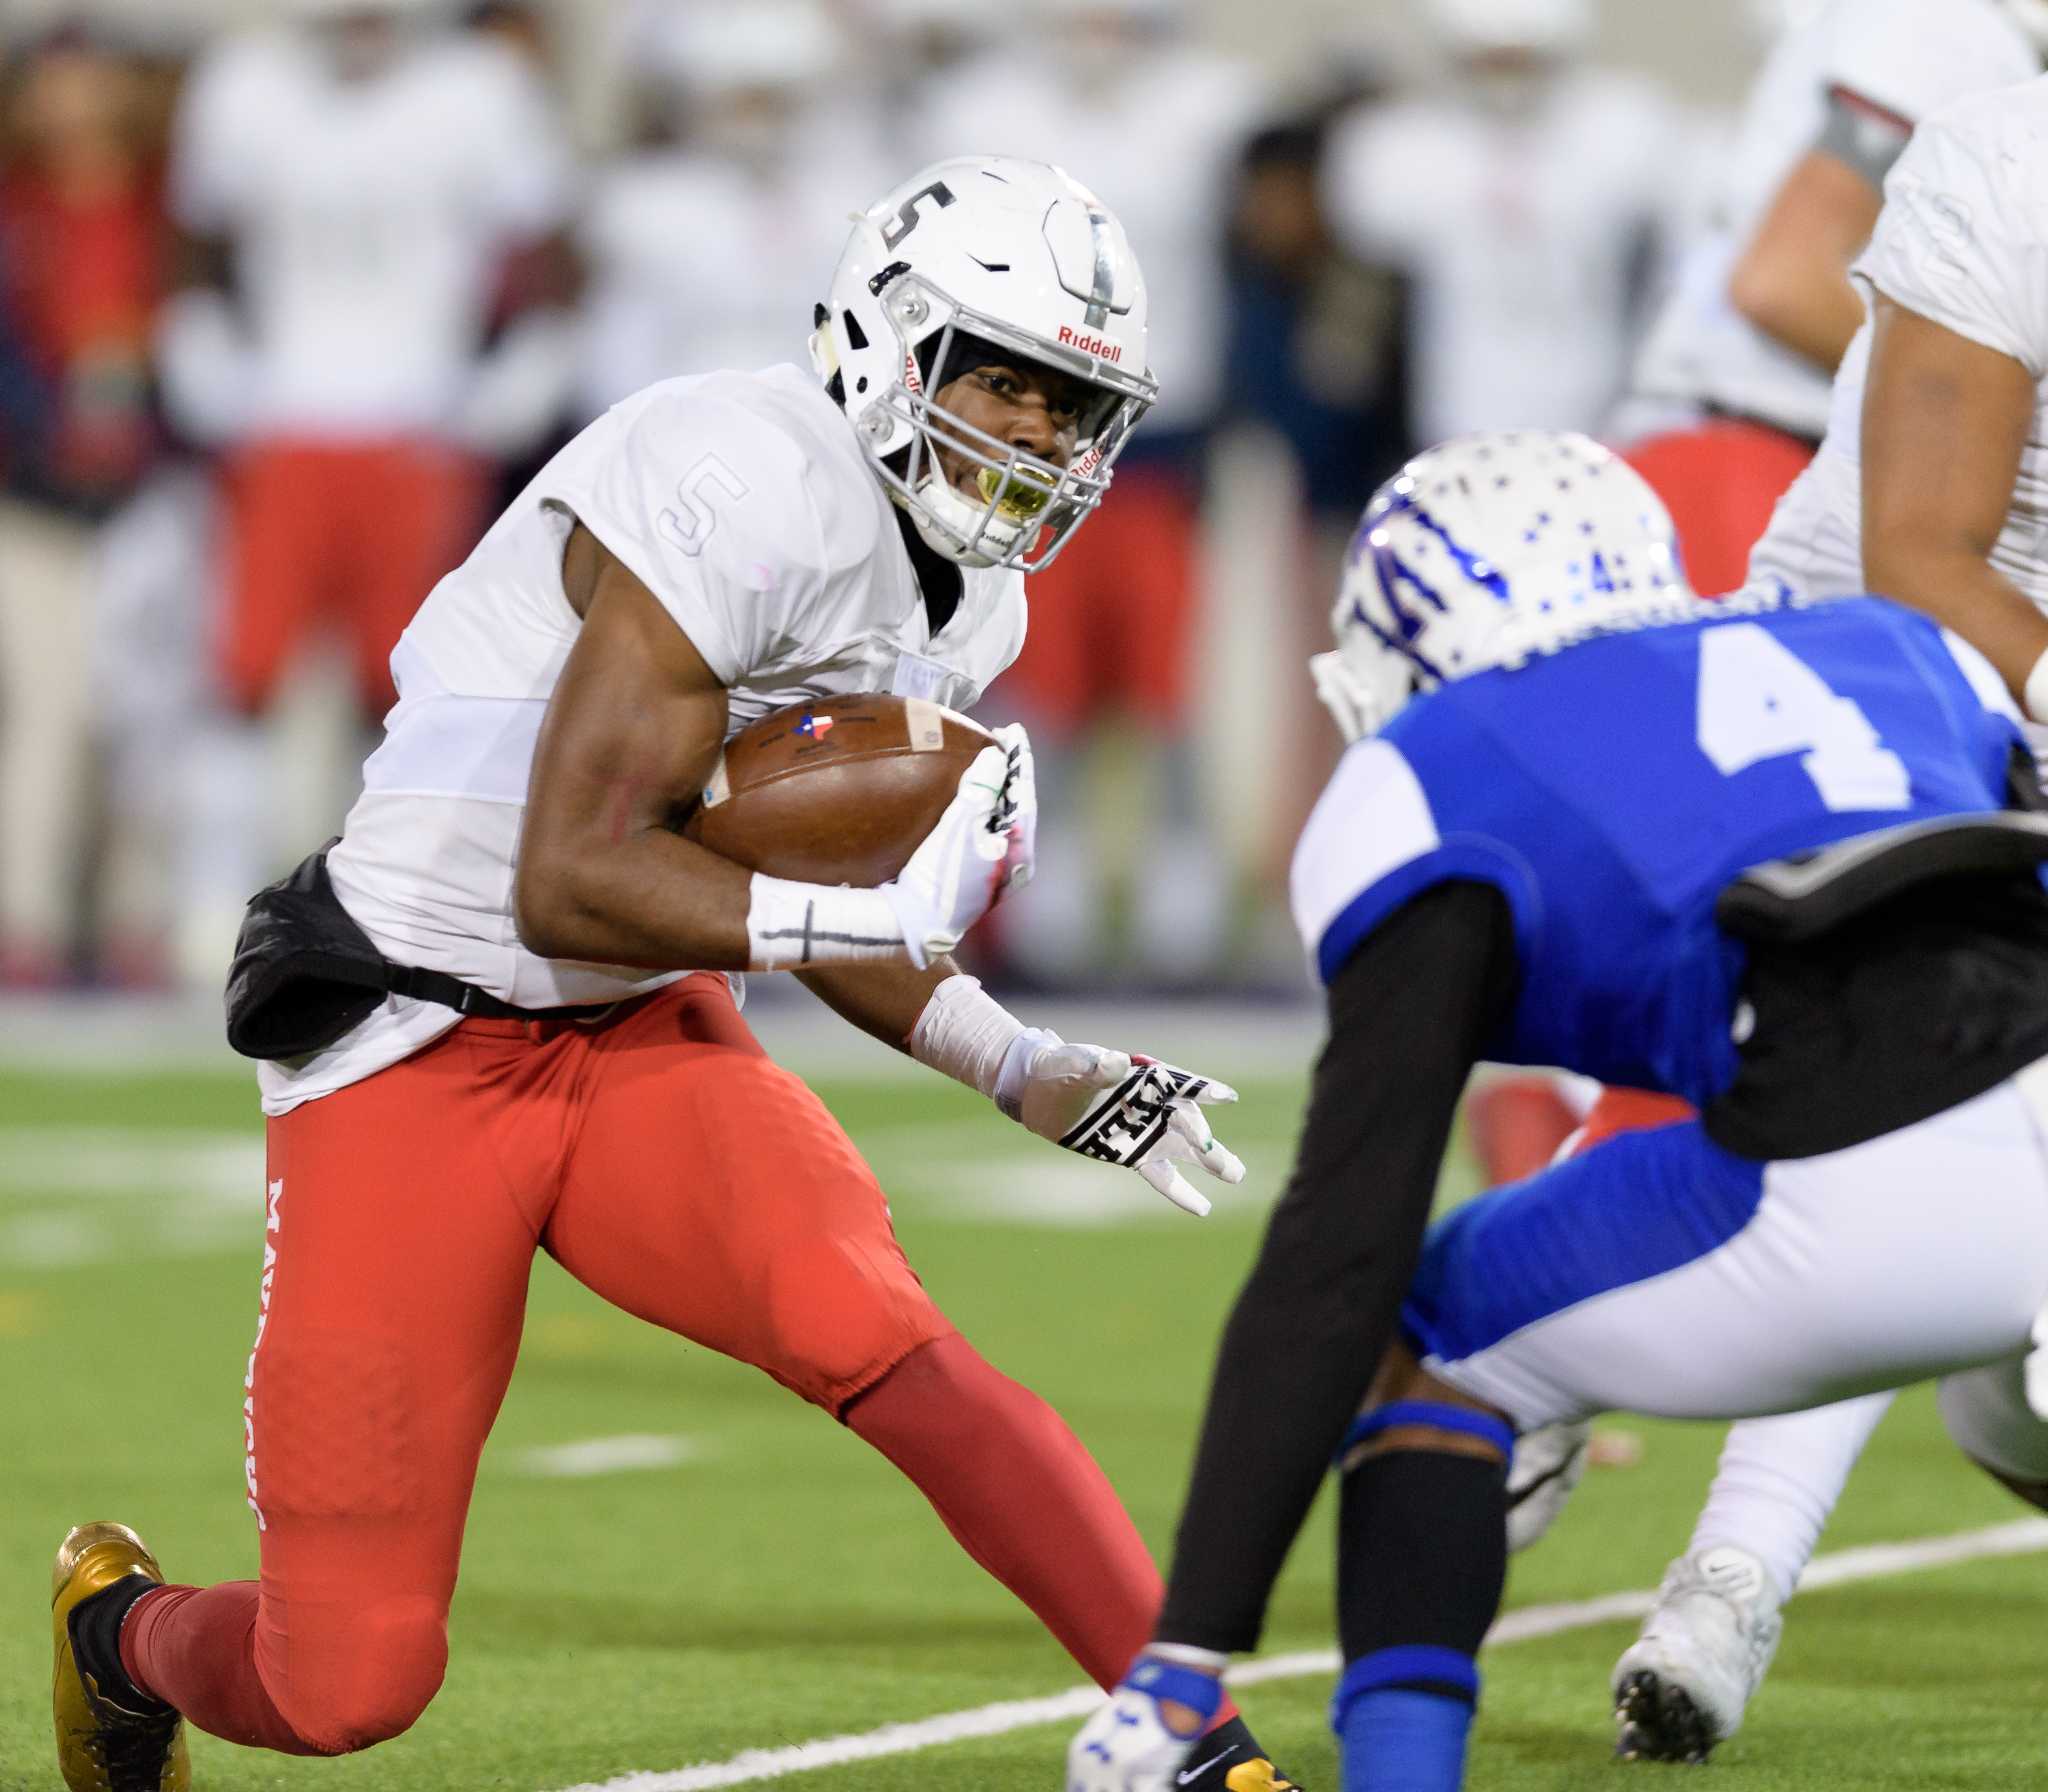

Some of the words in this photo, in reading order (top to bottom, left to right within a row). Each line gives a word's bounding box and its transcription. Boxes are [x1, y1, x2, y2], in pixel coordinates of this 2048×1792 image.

[881, 181, 958, 252] 5
[1058, 325, 1122, 363] Riddell
[656, 452, 750, 557] 5
[1696, 621, 1912, 812] 4
